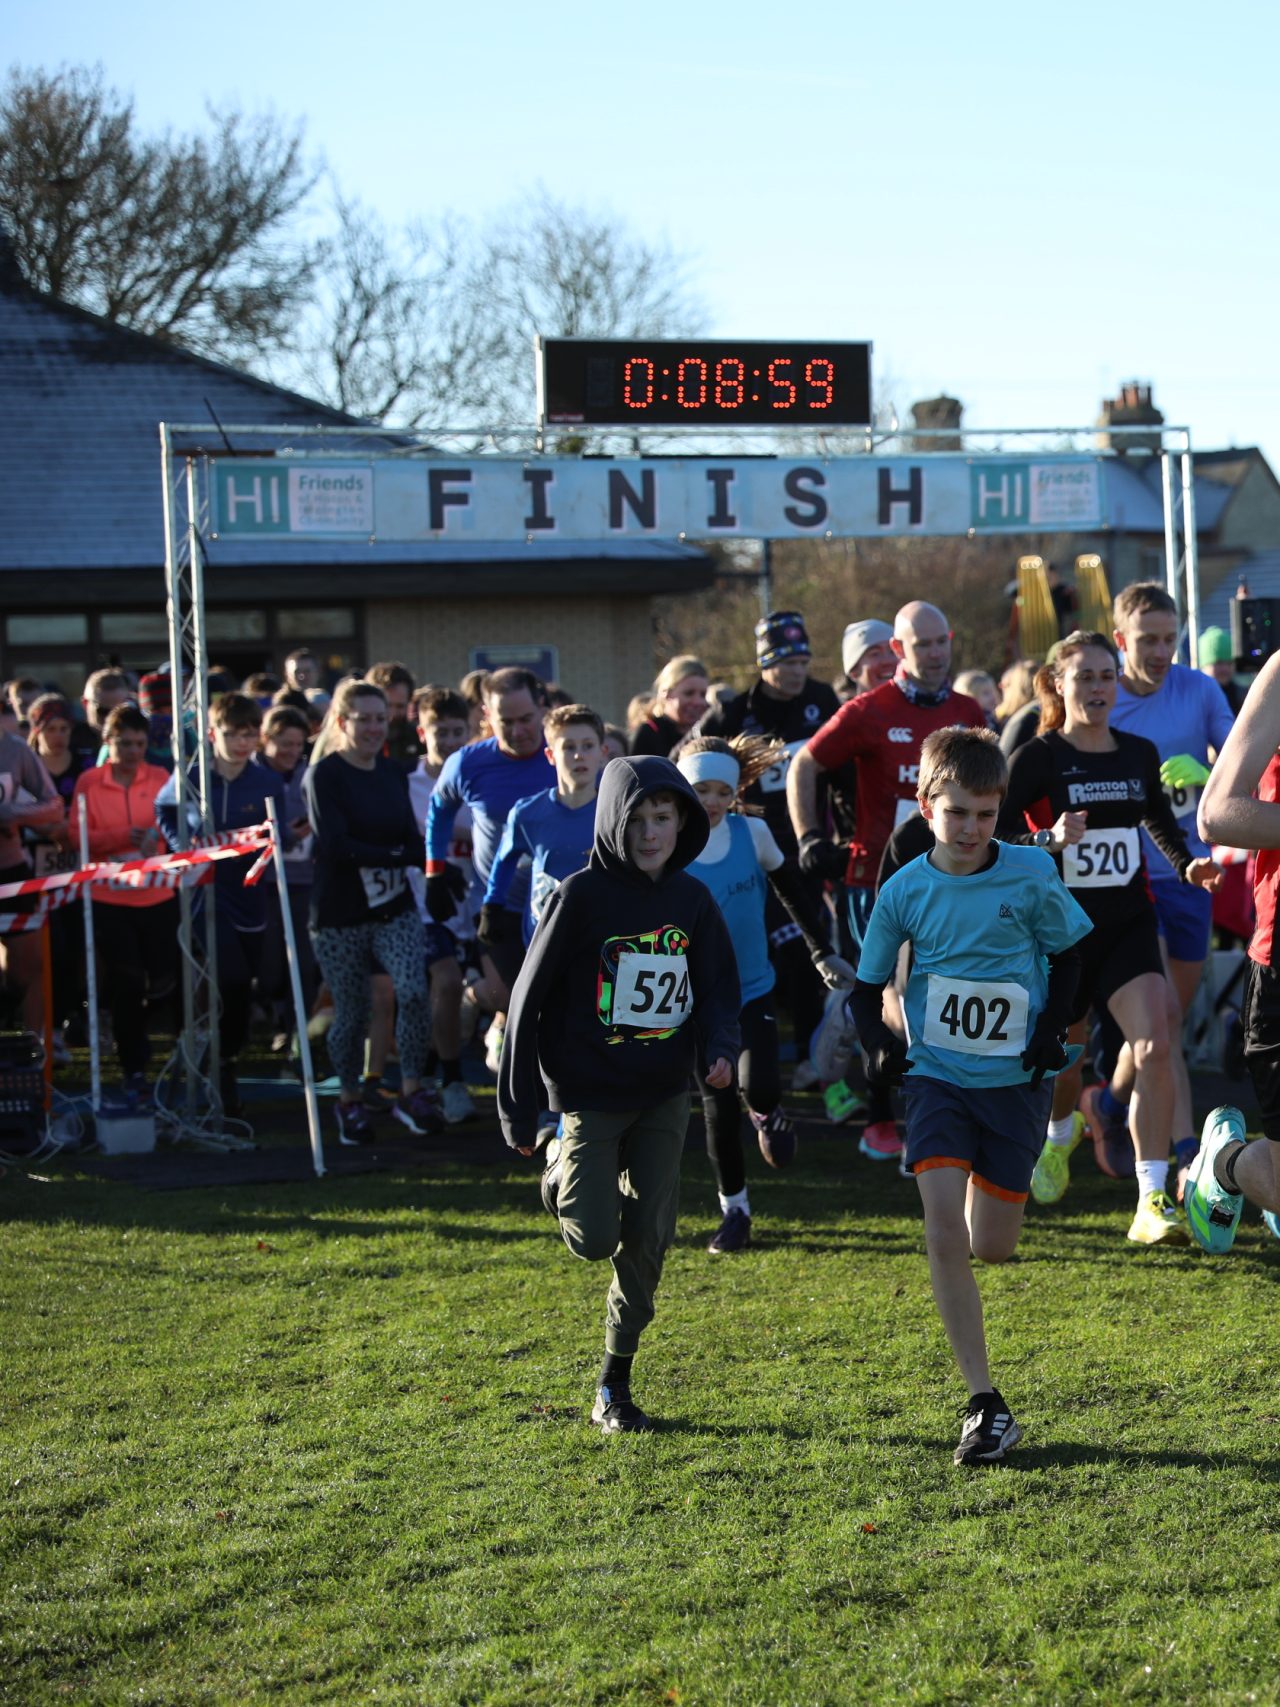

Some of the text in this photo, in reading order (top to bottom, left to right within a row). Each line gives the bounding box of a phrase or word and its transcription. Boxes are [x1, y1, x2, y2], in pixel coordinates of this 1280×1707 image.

[624, 357, 834, 408] 0:08:59
[227, 476, 280, 523] HI
[299, 474, 364, 490] Friends
[427, 466, 923, 530] FINISH
[979, 472, 1022, 518] HI
[372, 867, 406, 897] 51
[1077, 841, 1129, 877] 520
[630, 970, 689, 1014] 524
[939, 993, 1011, 1041] 402
